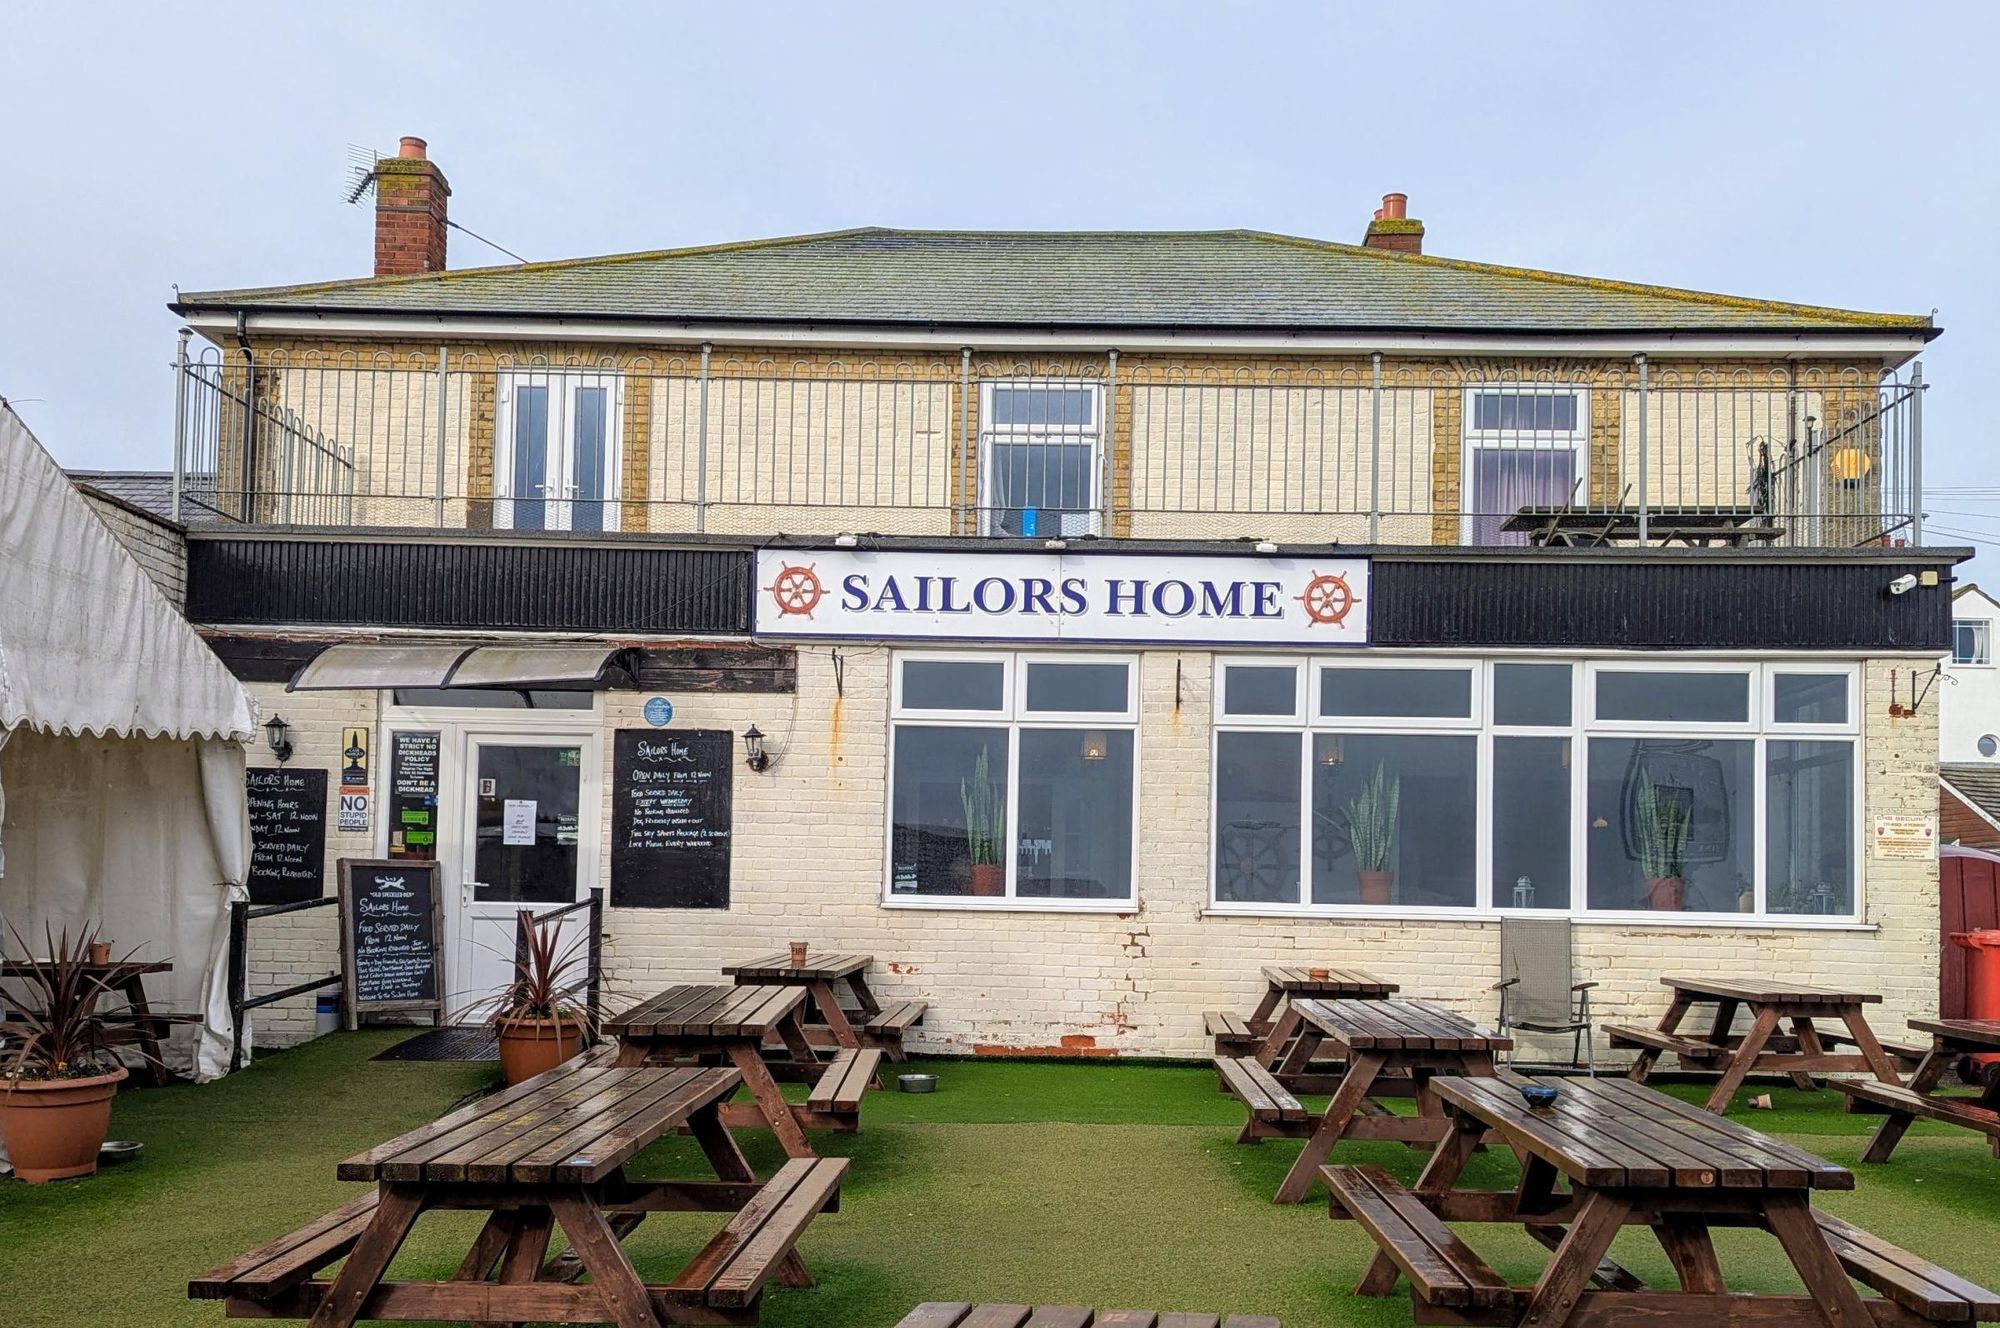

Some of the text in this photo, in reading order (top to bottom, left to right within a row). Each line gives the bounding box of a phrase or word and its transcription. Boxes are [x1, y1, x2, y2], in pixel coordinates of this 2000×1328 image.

[842, 574, 1285, 619] SAILORS HOME
[671, 743, 688, 756] HOME
[632, 769, 651, 780] OPEN
[653, 771, 670, 779] DAILY
[673, 771, 687, 779] FROM
[284, 775, 305, 787] HOME
[340, 796, 367, 811] NO
[290, 811, 299, 820] 12
[301, 812, 318, 820] NOON
[275, 824, 282, 833] 12
[259, 841, 285, 851] SERVED
[287, 843, 310, 853] DAILY
[254, 853, 273, 862] FROM
[277, 854, 284, 862] 12
[358, 920, 373, 933] FOOD
[400, 924, 420, 932] DAILY
[364, 936, 380, 945] FROM
